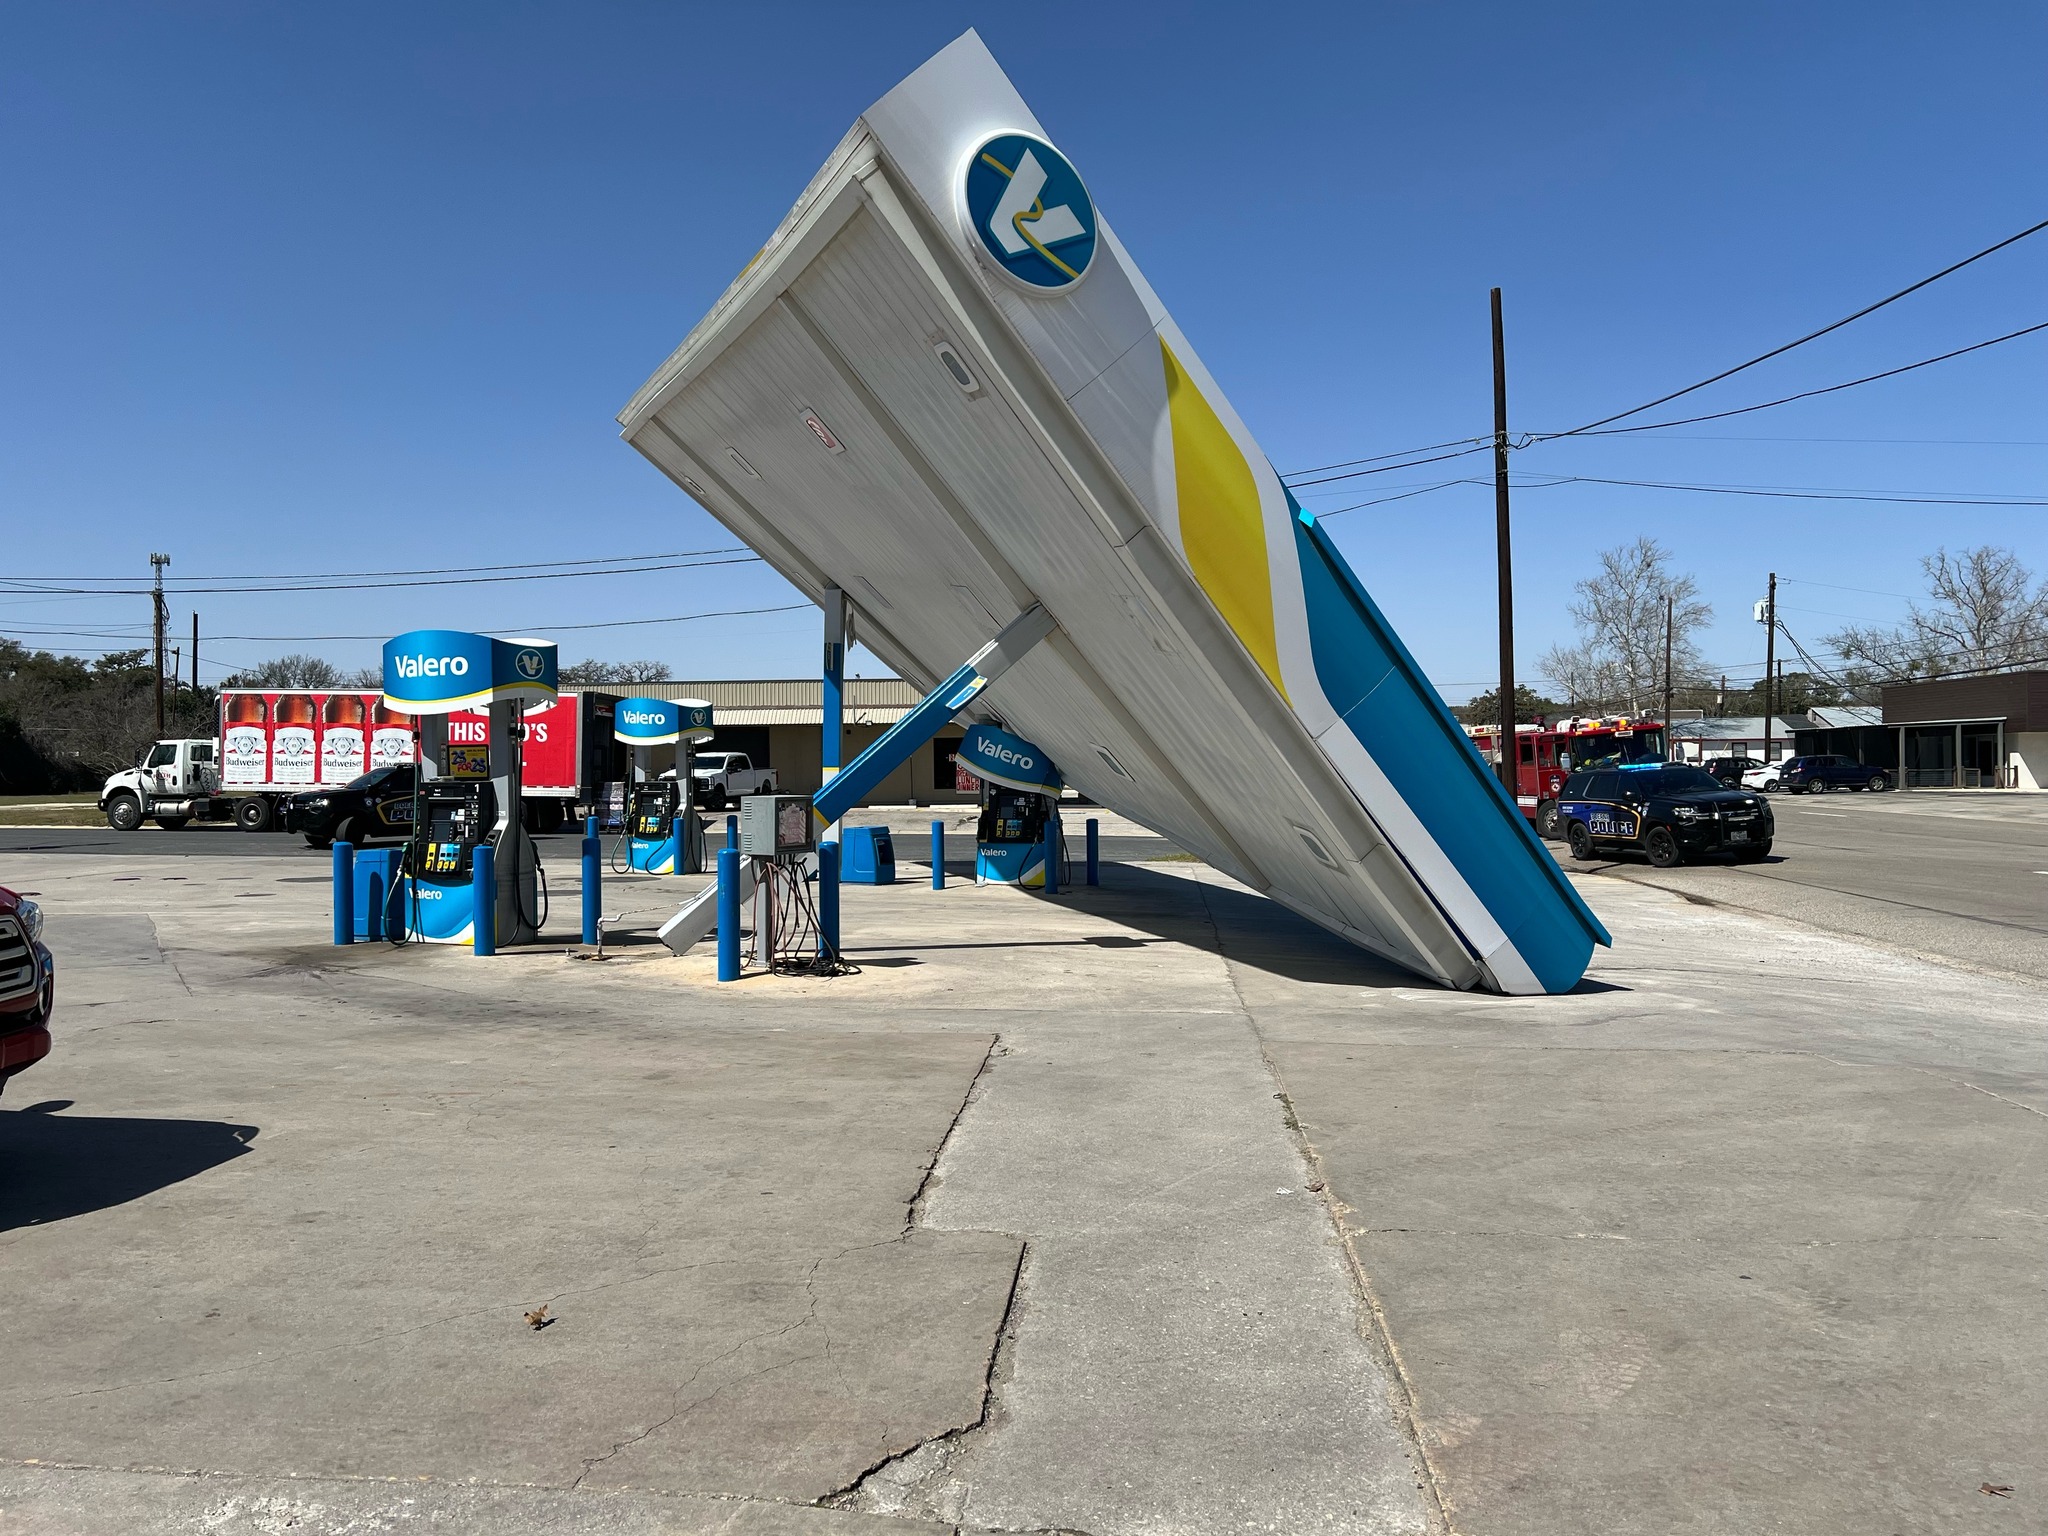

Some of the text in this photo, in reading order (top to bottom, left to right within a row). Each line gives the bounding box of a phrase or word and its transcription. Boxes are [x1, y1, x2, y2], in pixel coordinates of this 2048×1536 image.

[394, 653, 469, 678] Valero
[623, 710, 665, 725] Valero
[448, 722, 486, 742] THIS
[977, 736, 1034, 770] Valero
[225, 757, 265, 767] Budweiser
[274, 757, 314, 767] Budweiser
[323, 758, 363, 768] Budweiser
[451, 750, 467, 765] 25
[470, 757, 486, 773] 25
[1588, 819, 1634, 836] POLICE
[980, 848, 1008, 857] Valero
